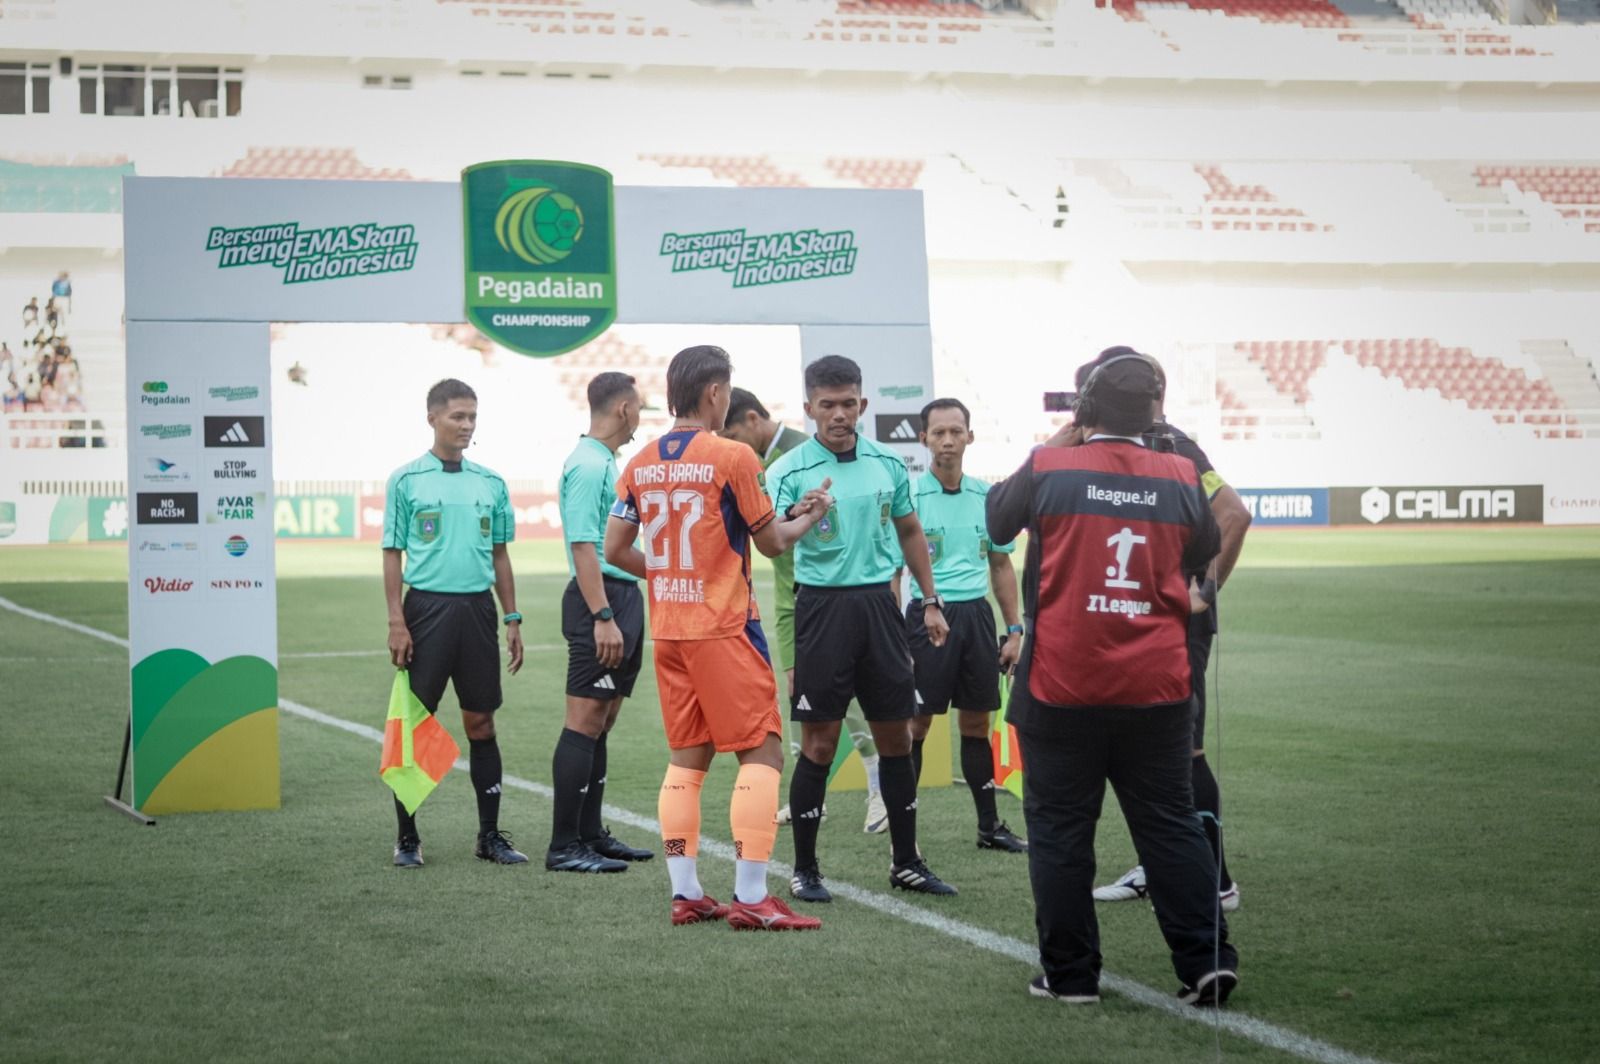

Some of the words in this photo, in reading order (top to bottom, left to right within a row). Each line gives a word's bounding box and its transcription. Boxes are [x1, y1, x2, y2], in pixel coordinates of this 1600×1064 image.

[208, 223, 296, 248] Bersama
[221, 224, 412, 265] mengEMASkan
[662, 230, 744, 253] Bersama
[674, 231, 852, 271] mengEMASkan
[286, 244, 416, 282] Indonesia!
[735, 250, 856, 286] Indonesia!
[478, 276, 603, 303] Pegadaian
[492, 314, 591, 327] CHAMPIONSHIP
[141, 395, 190, 406] Pegadaian
[214, 470, 256, 479] BULLYING
[223, 461, 247, 469] STOP
[160, 499, 175, 508] NO
[217, 496, 254, 507] #VAR
[1087, 485, 1157, 506] ileague.id
[1259, 494, 1313, 518] CENTER
[1395, 489, 1515, 519] CALMA
[151, 508, 185, 518] RACISM
[224, 509, 254, 520] FAIR
[274, 498, 342, 534] AIR
[640, 489, 704, 570] 27
[144, 577, 194, 594] Vidio
[211, 580, 231, 589] SIN
